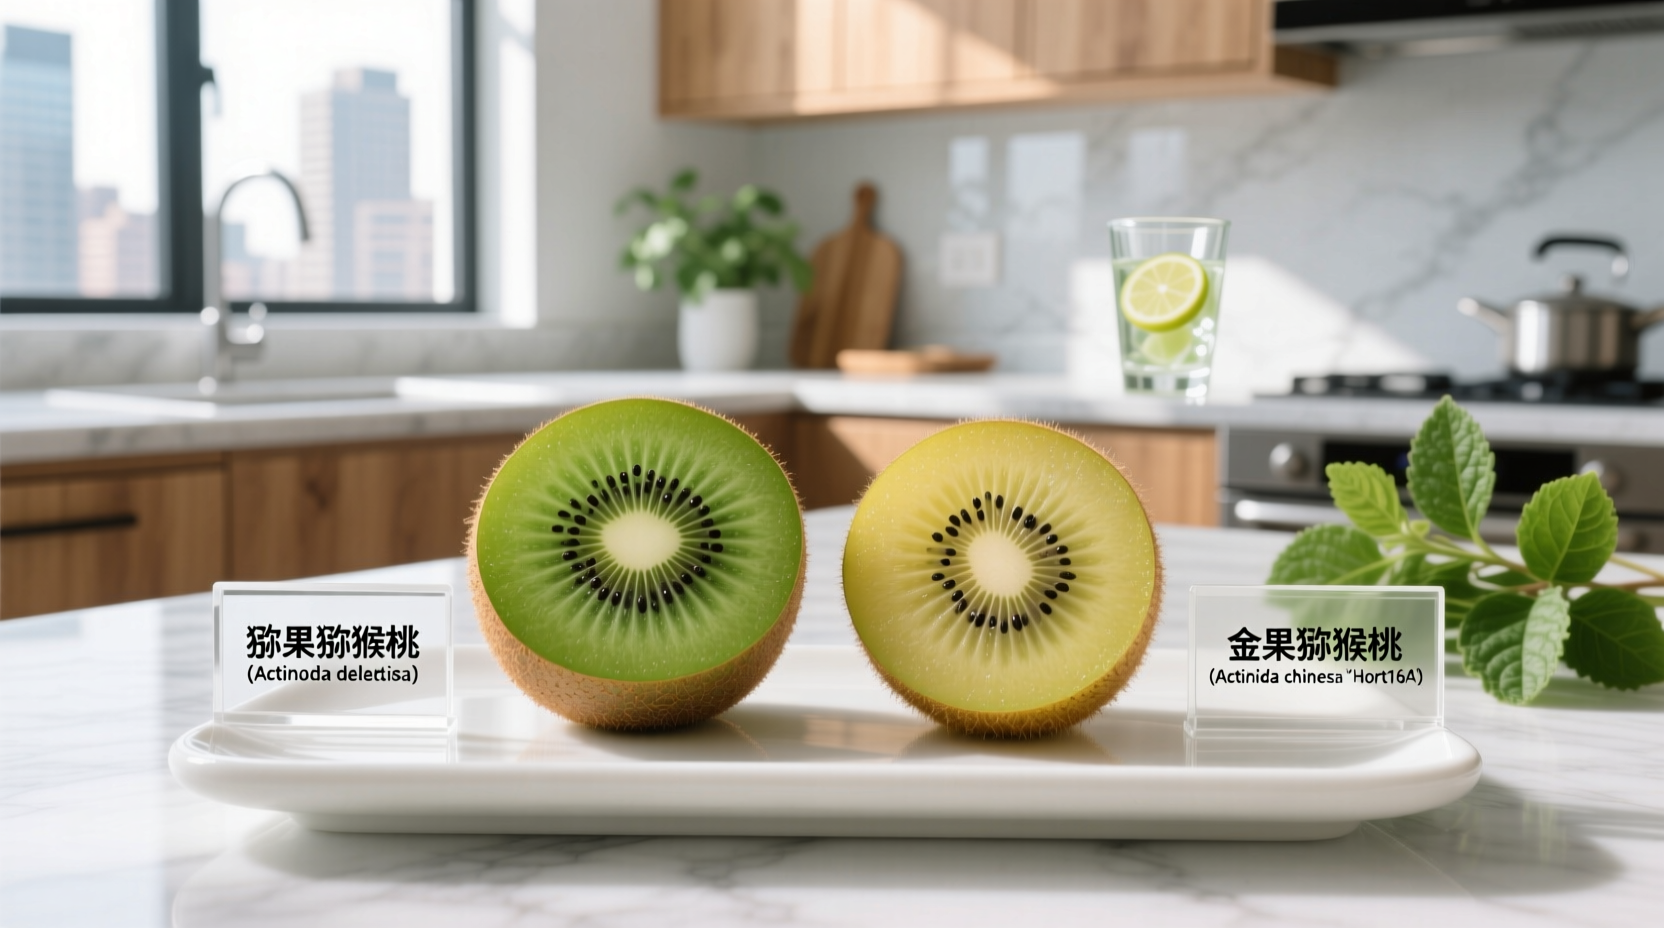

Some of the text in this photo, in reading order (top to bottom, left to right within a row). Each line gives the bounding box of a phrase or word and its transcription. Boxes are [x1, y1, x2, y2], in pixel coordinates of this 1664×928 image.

[1227, 626, 1403, 662] 金果猕猴桃
[247, 664, 331, 685] (Actinoda
[1209, 667, 1279, 687] (Actinida
[1284, 668, 1343, 684] chinesa
